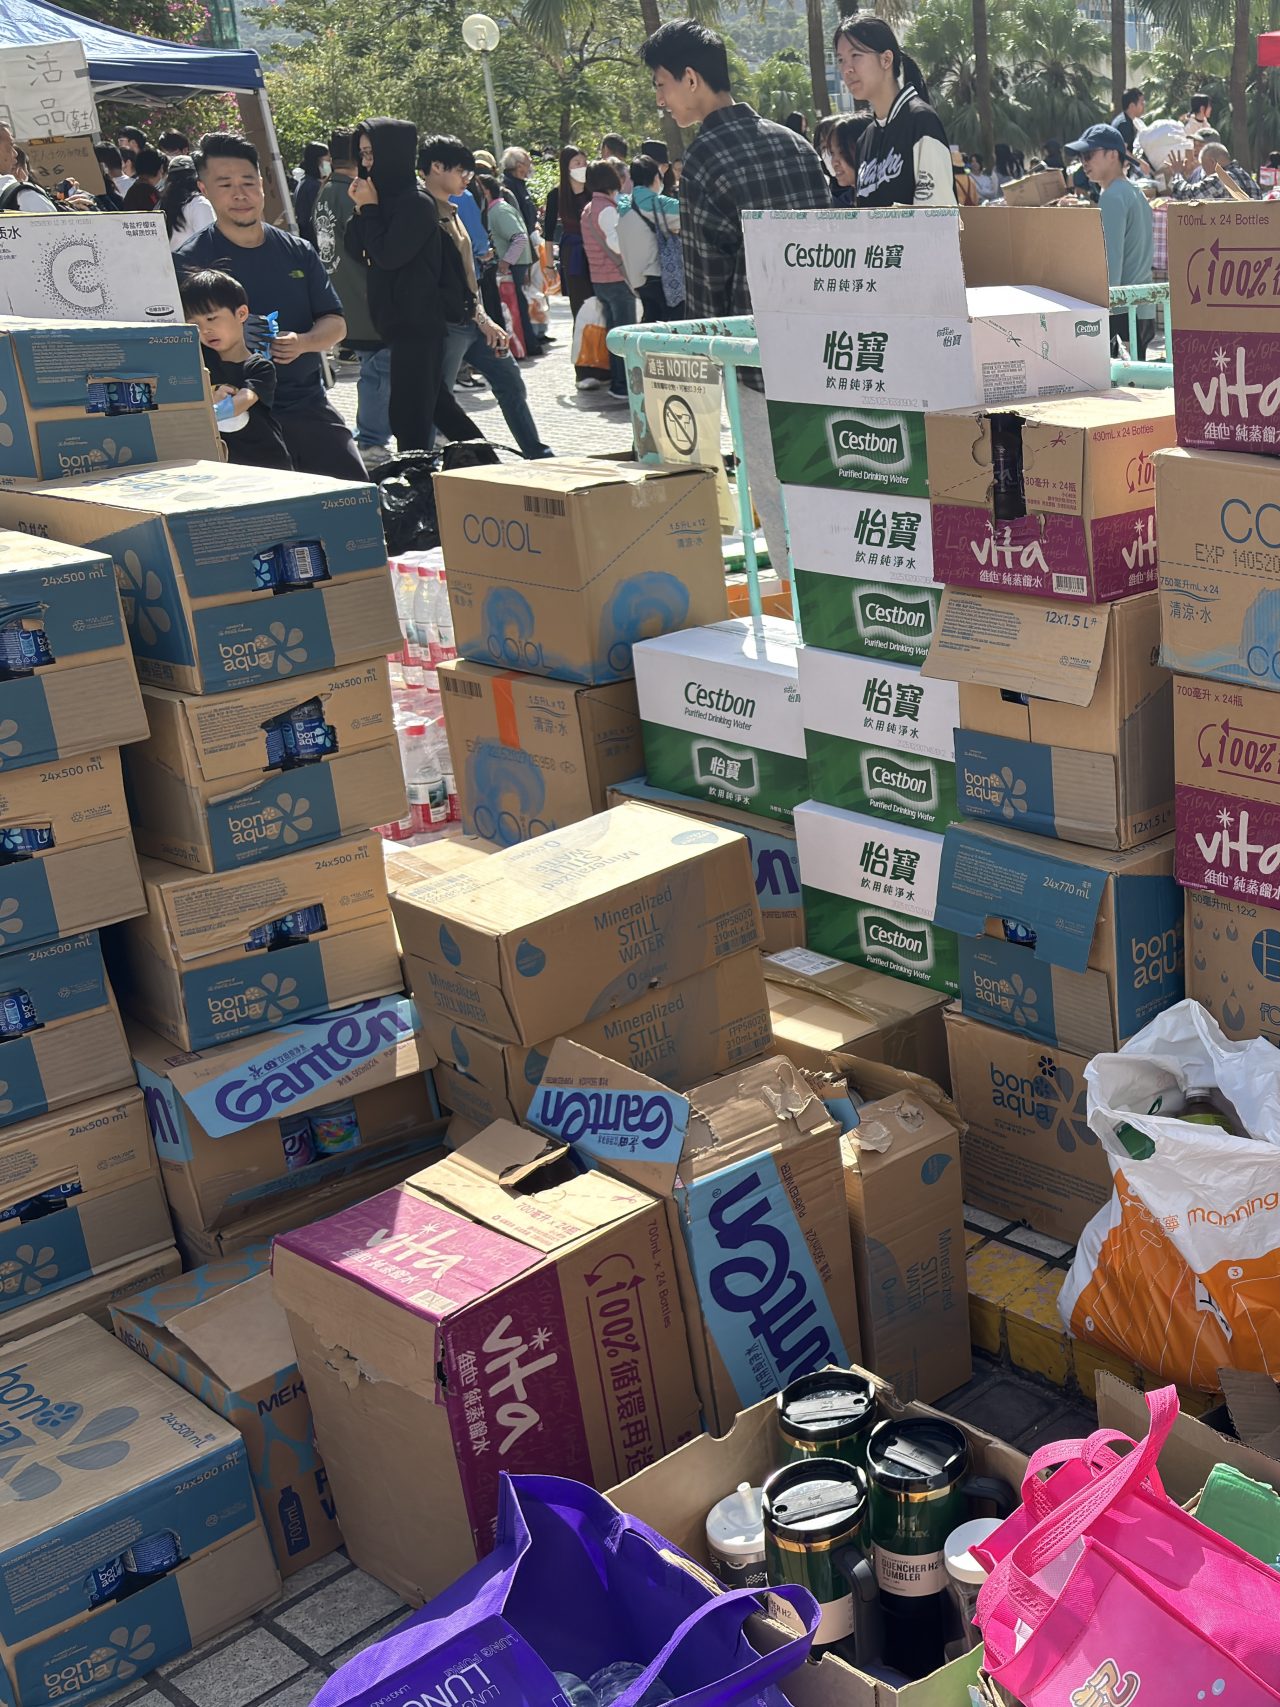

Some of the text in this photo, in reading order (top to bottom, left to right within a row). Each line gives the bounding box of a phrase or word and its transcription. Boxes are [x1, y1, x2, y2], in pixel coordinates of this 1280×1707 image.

[1177, 214, 1206, 226] 700mL
[1220, 214, 1232, 226] 24
[1235, 213, 1269, 226] Bottles
[864, 244, 904, 270] 怡寶
[813, 278, 877, 293] 飲用純淨水
[823, 330, 889, 374] 怡寶
[666, 360, 708, 379] NOTICE
[826, 377, 886, 393] 飲用純淨水
[1093, 430, 1115, 441] 430mL
[1123, 427, 1130, 436] 24
[1132, 425, 1153, 436] Bottles
[838, 468, 909, 485] Purified Drinking Water
[321, 494, 373, 511] 24x500 mL
[854, 508, 922, 551] 怡寶
[855, 551, 916, 570] 飲用純淨水
[1195, 543, 1225, 567] EXP
[41, 568, 107, 587] 24x500 mL
[219, 640, 256, 660] bon
[223, 653, 273, 672] aqua
[328, 673, 377, 692] 24x500 mL
[862, 678, 924, 722] 怡寶
[1177, 685, 1212, 700] 700毫升
[1222, 692, 1243, 708] 24瓶
[685, 707, 752, 730] Purified Drinking Water
[863, 717, 920, 739] 飲用純淨水
[40, 759, 104, 784] 24x500 mL
[710, 756, 741, 781] 怡寶
[869, 798, 936, 823] Purified Drinking Water
[228, 814, 264, 833] bon
[232, 826, 279, 846] aqua
[315, 850, 370, 871] 24x500 mL
[859, 841, 921, 886] 怡寶
[593, 885, 673, 932] Mineralized
[617, 913, 661, 946] STILL
[619, 934, 665, 964] WATER
[207, 991, 247, 1013] bon
[211, 1005, 262, 1026] aqua
[991, 1062, 1035, 1098] bon
[68, 1109, 128, 1137] 24x500 mL
[482, 1315, 559, 1455] vita
[257, 1380, 307, 1416] MEK
[881, 1559, 927, 1573] QUENCHER
[882, 1567, 921, 1581] TUMBLER
